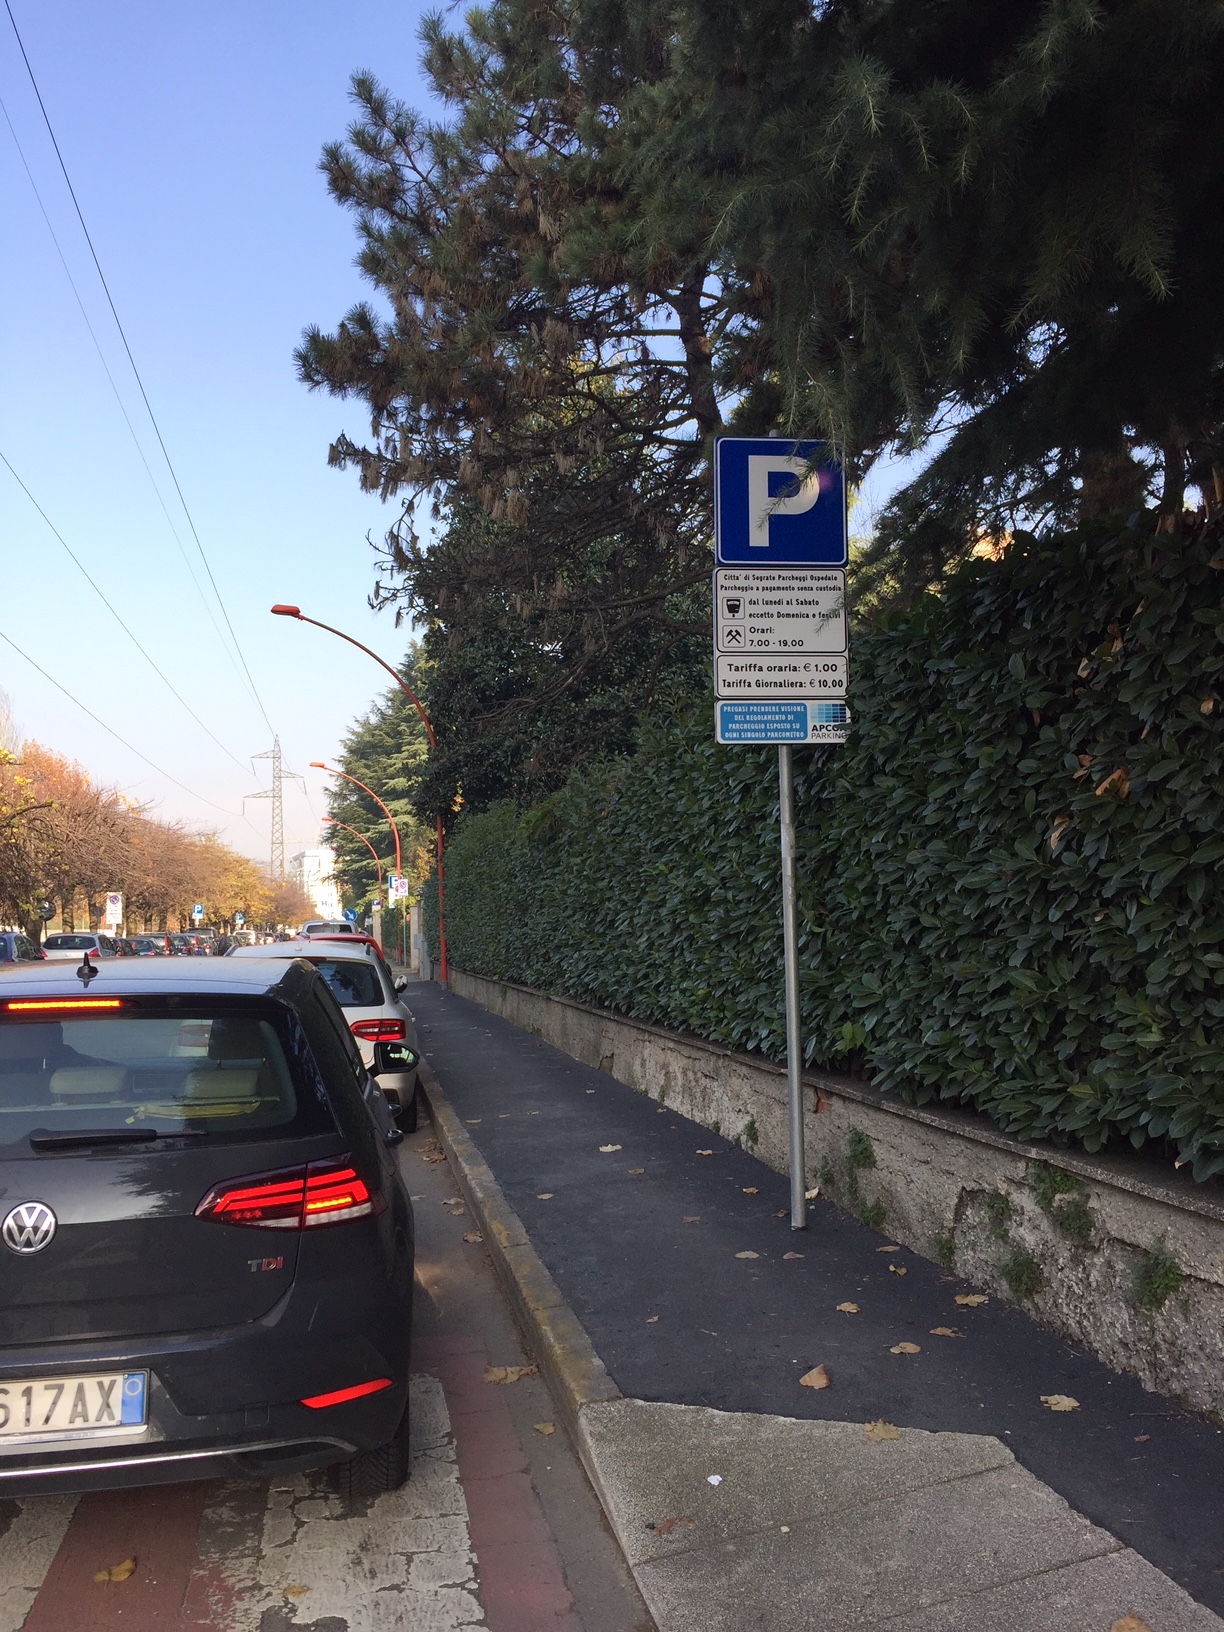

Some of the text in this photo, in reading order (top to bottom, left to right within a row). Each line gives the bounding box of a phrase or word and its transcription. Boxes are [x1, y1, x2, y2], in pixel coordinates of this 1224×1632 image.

[748, 455, 820, 547] P
[752, 574, 776, 582] Segrate
[777, 574, 808, 582] Parcheggi
[809, 574, 838, 582] Ospedale
[748, 598, 760, 606] dal
[786, 598, 793, 606] al
[795, 598, 820, 606] Sabato
[749, 626, 775, 634] Orari:
[749, 639, 770, 647] 7.00
[778, 639, 804, 647] 19.00
[727, 663, 763, 672] Tariffa
[766, 664, 801, 672] oraria:
[814, 663, 838, 673] 1.00
[722, 679, 752, 688] Tariffa
[755, 679, 806, 688] Giornaliera:
[818, 679, 843, 689] 10.00
[195, 904, 202, 913] P
[248, 1256, 284, 1272] TDI
